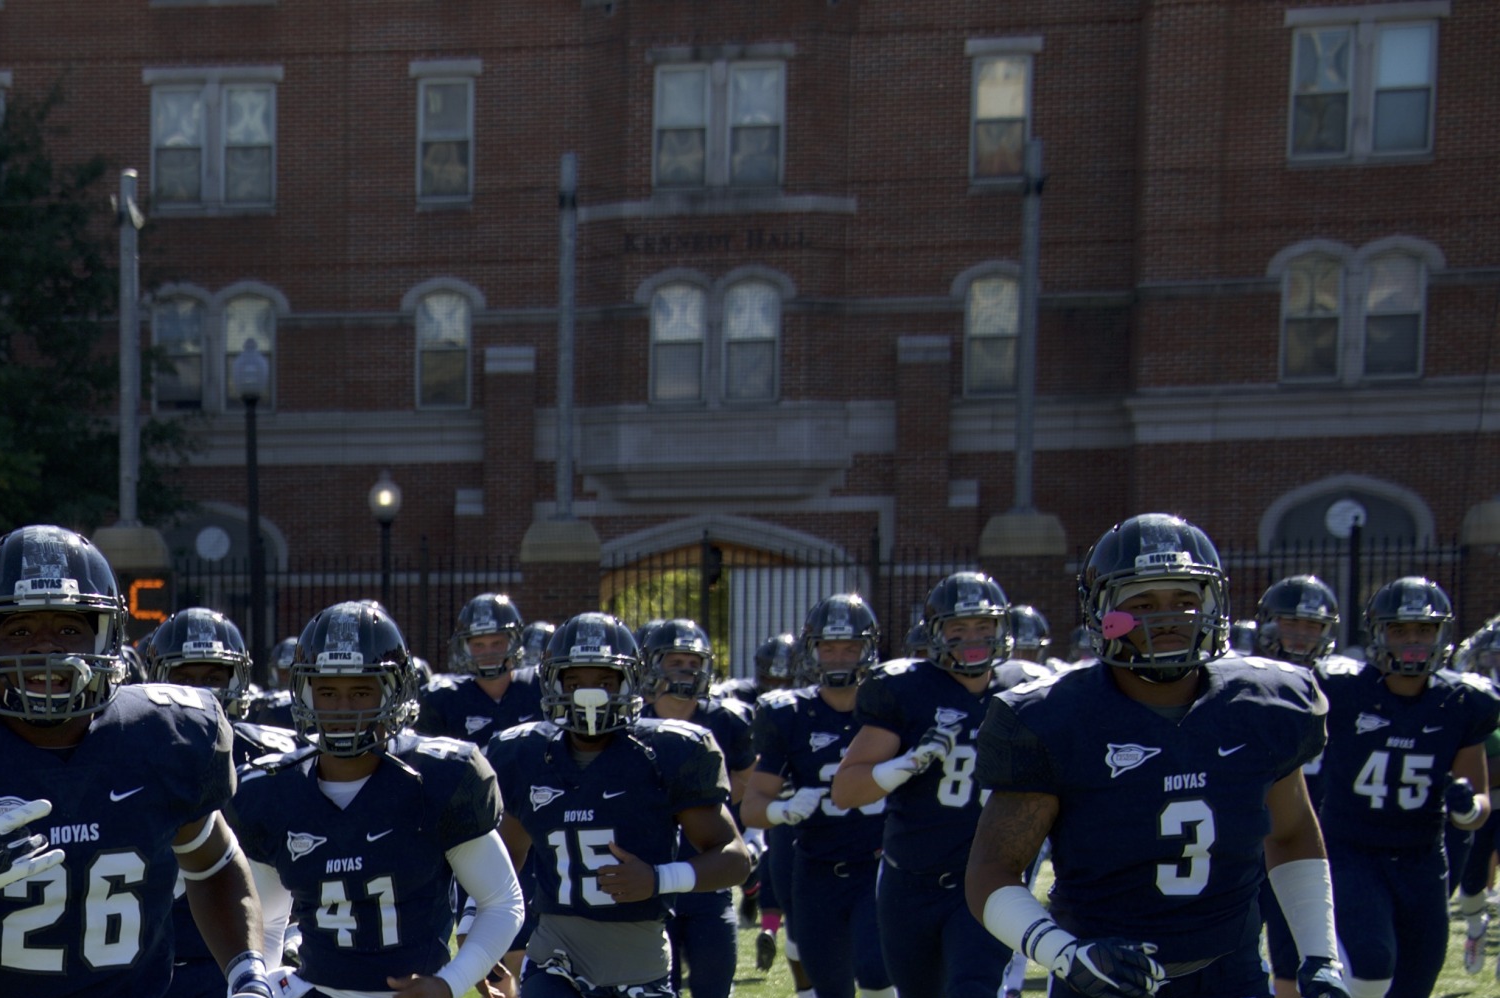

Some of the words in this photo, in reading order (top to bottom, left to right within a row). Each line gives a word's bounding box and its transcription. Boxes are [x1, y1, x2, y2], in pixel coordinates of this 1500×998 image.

[1148, 553, 1177, 564] HOYAS
[30, 578, 63, 590] HOYAS
[328, 652, 353, 660] HOYAS
[1385, 736, 1416, 749] HOYAS
[1164, 772, 1207, 792] HOYAS
[1353, 751, 1436, 810] 45
[563, 809, 595, 823] HOYAS
[50, 822, 100, 845] HOYAS
[1155, 799, 1216, 896] 3
[326, 856, 363, 874] HOYAS
[547, 829, 620, 906] 15
[1, 851, 146, 972] 26
[316, 875, 399, 947] 41
